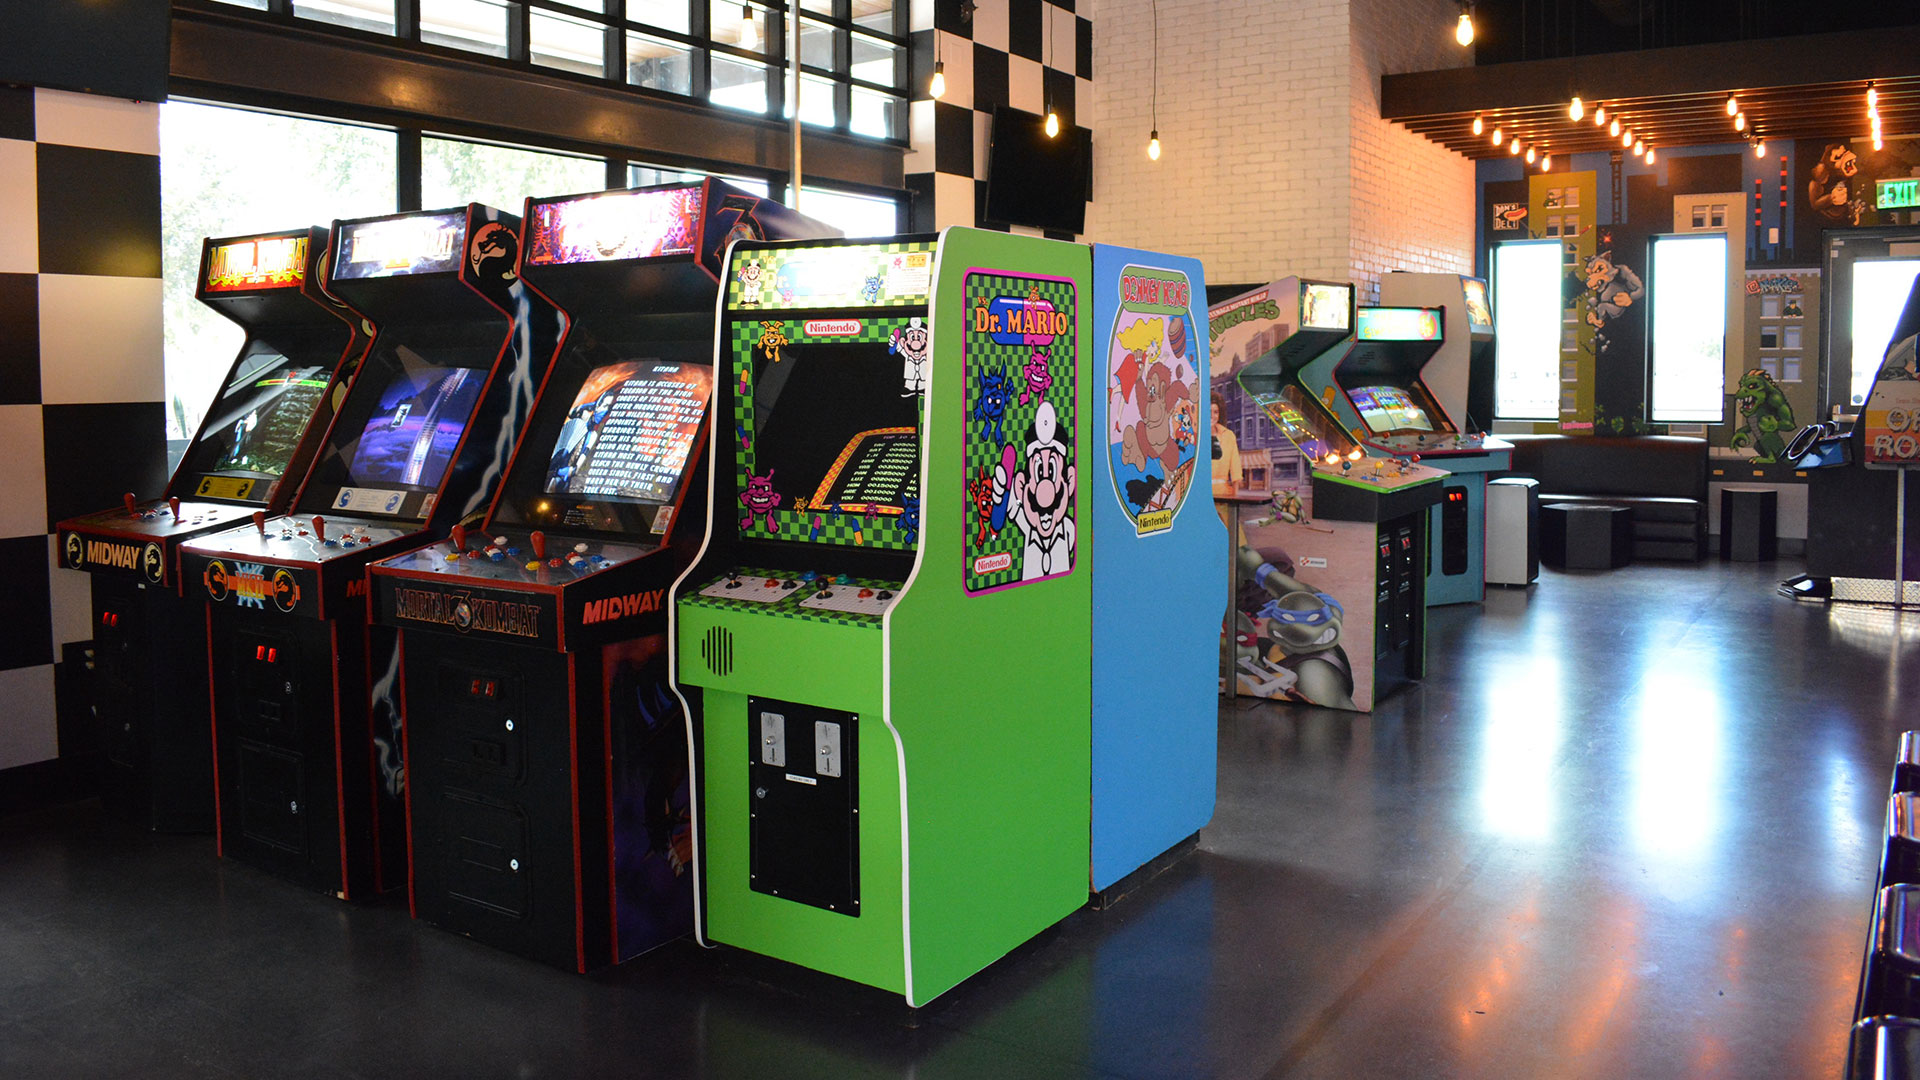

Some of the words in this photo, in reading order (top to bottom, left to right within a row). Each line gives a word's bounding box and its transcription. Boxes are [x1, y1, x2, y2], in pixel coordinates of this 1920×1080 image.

[1883, 181, 1918, 208] EXIT
[1495, 218, 1516, 229] DELI
[1122, 275, 1161, 304] DONKEY
[1162, 280, 1189, 308] KONG
[810, 323, 857, 333] Nintendo
[975, 306, 1002, 333] Dr.
[1006, 308, 1068, 336] MARIO
[655, 475, 674, 484] AND
[1140, 514, 1169, 528] Nintendo
[87, 540, 140, 570] MIDWAY
[977, 556, 1008, 571] Nintendo
[395, 587, 457, 626] MORTAL
[471, 598, 542, 638] KOMBAT
[582, 587, 665, 625] MIDWAY
